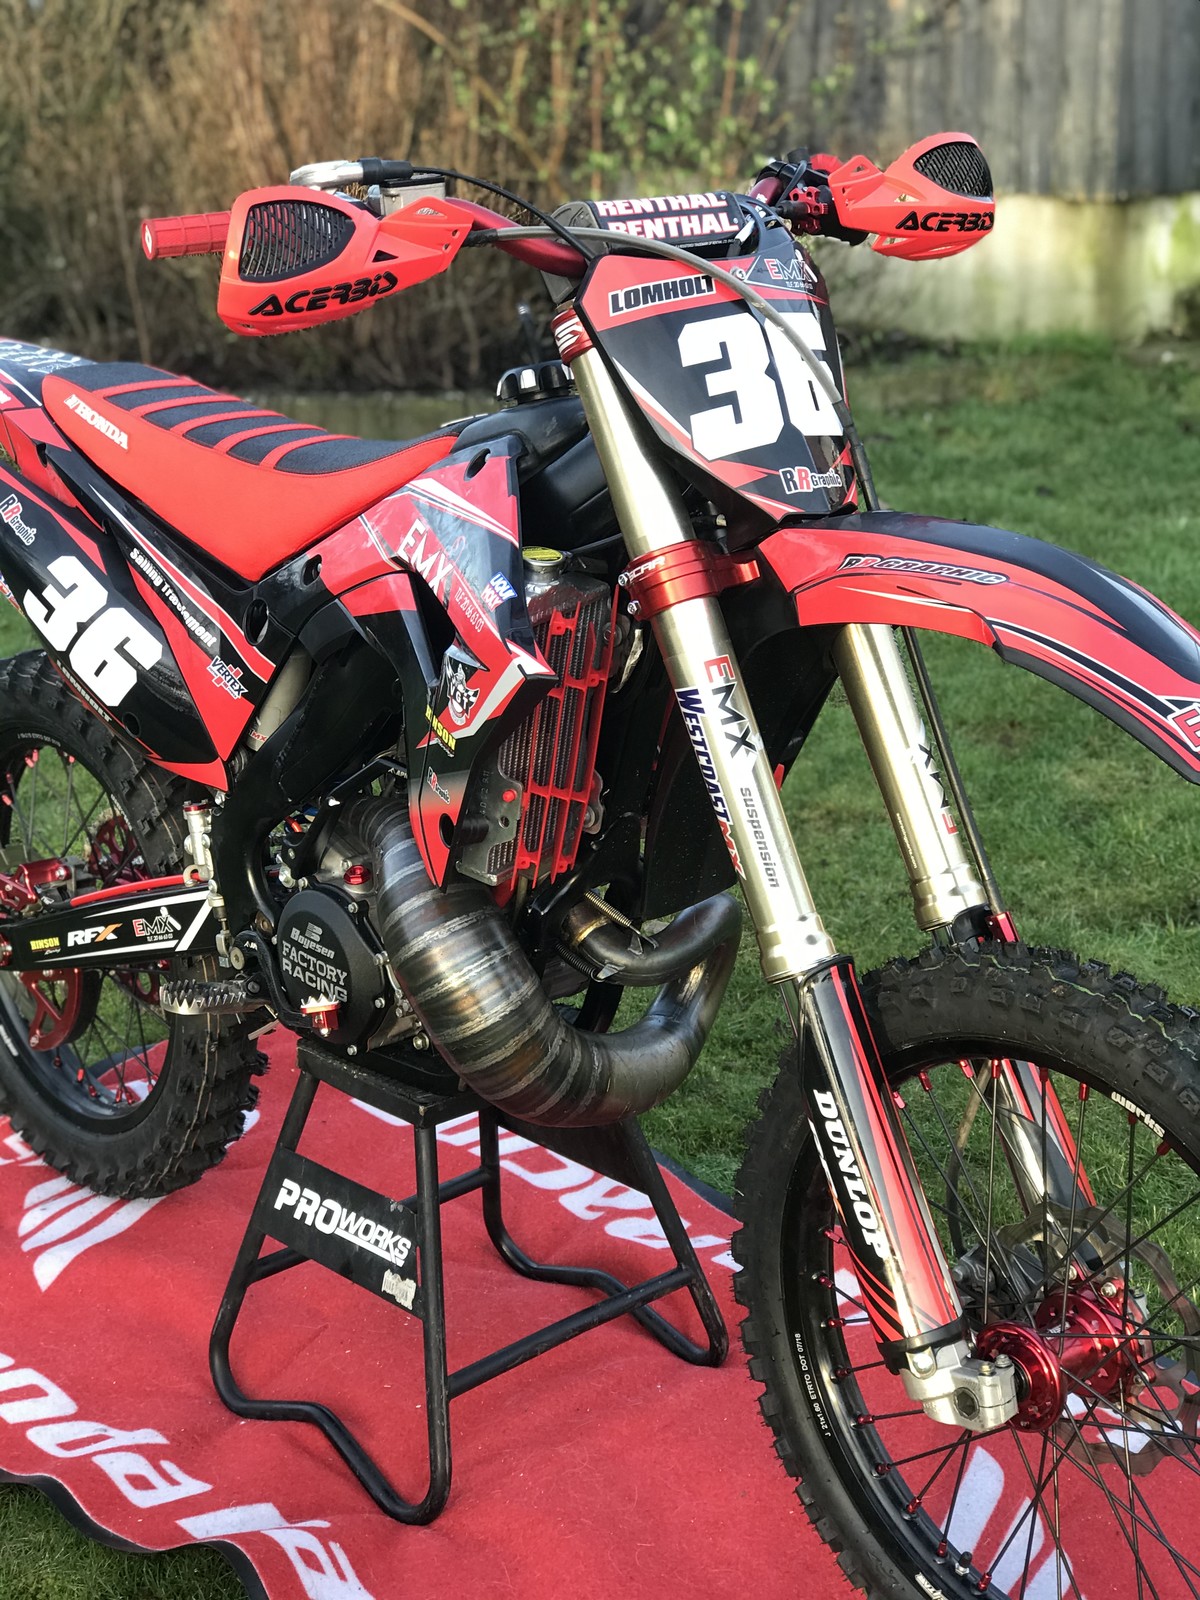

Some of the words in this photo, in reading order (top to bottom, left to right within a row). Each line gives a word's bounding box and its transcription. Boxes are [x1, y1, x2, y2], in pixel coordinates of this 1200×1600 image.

[594, 192, 728, 217] RENTHAL
[608, 212, 739, 240] RENTHAL
[248, 271, 399, 316] ACERBIS
[610, 275, 715, 315] LOMHOLT
[677, 312, 844, 461] 36
[74, 399, 128, 450] HONDA
[780, 468, 812, 494] RR
[811, 469, 842, 487] Graphic
[0, 494, 23, 523] RR
[9, 514, 37, 546] Graphic
[23, 556, 162, 707] 36
[210, 656, 248, 698] VERTEX
[704, 654, 758, 758] EMX
[740, 786, 780, 888] suspension
[67, 923, 123, 947] RFX
[132, 914, 174, 937] EMX
[290, 927, 335, 959] Boyesen
[282, 940, 348, 986] FACTORY
[282, 958, 348, 1003] RACING
[813, 1089, 890, 1259] DUNLOP
[799, 1354, 808, 1371] DOT
[804, 1374, 817, 1400] ETRTO
